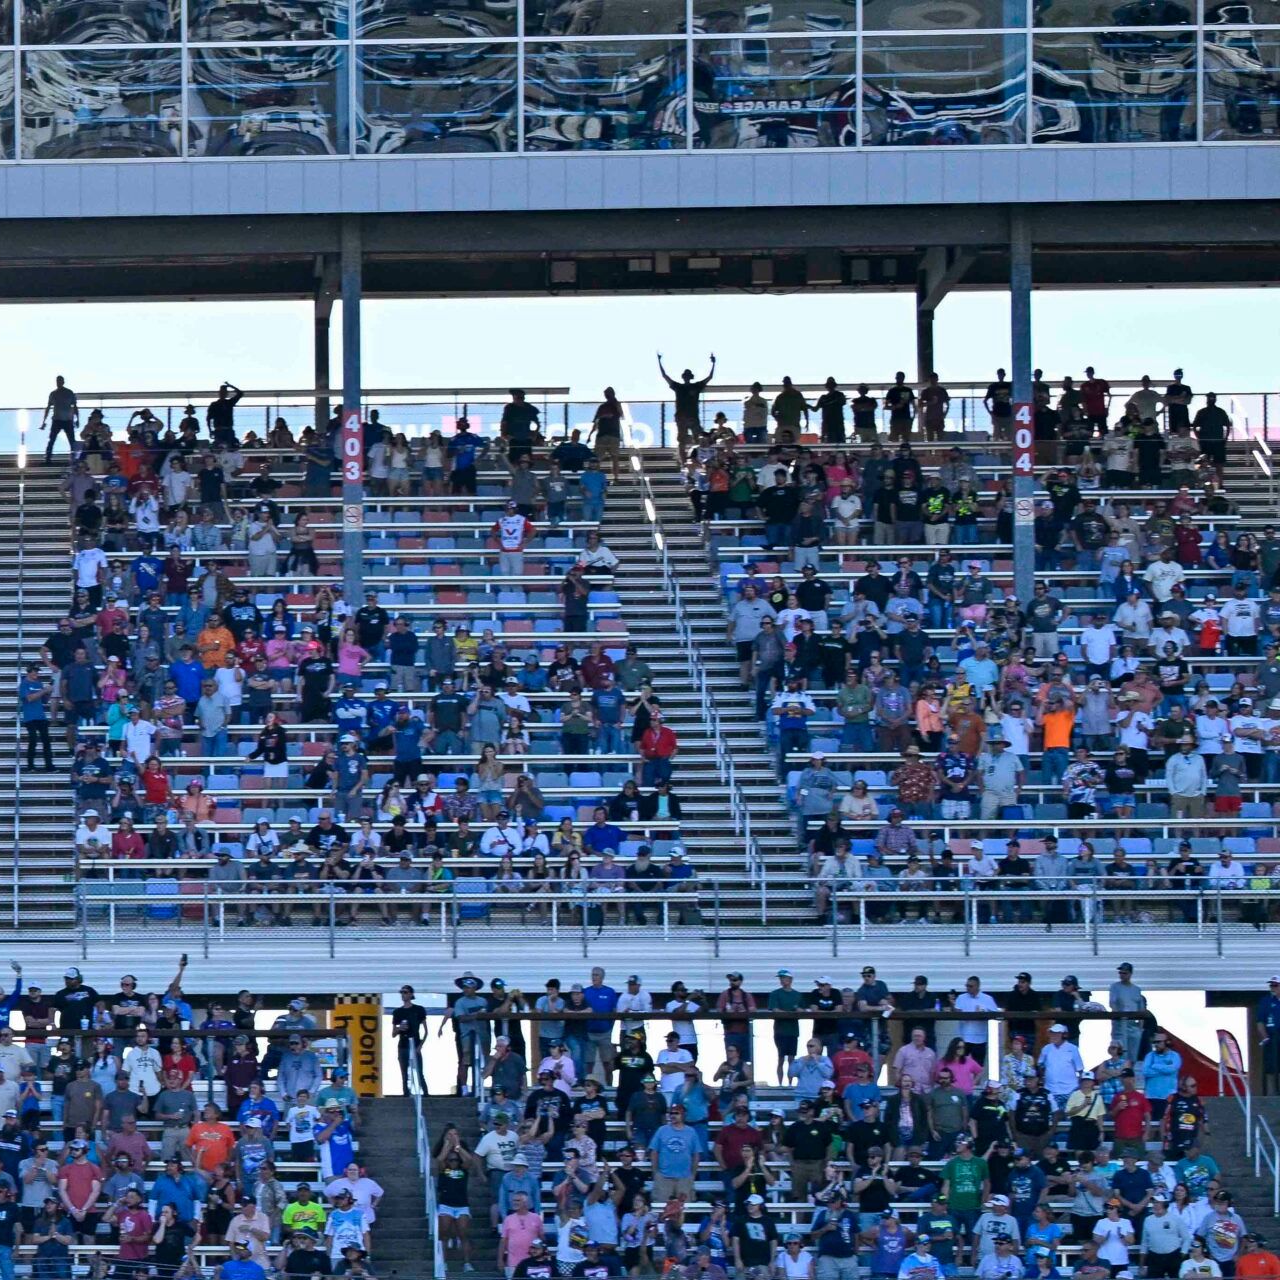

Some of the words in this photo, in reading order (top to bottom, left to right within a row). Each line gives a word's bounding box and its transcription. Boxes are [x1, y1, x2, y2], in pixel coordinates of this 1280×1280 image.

[344, 413, 362, 481] 403
[1014, 407, 1033, 473] 404
[359, 1015, 379, 1083] Don't
